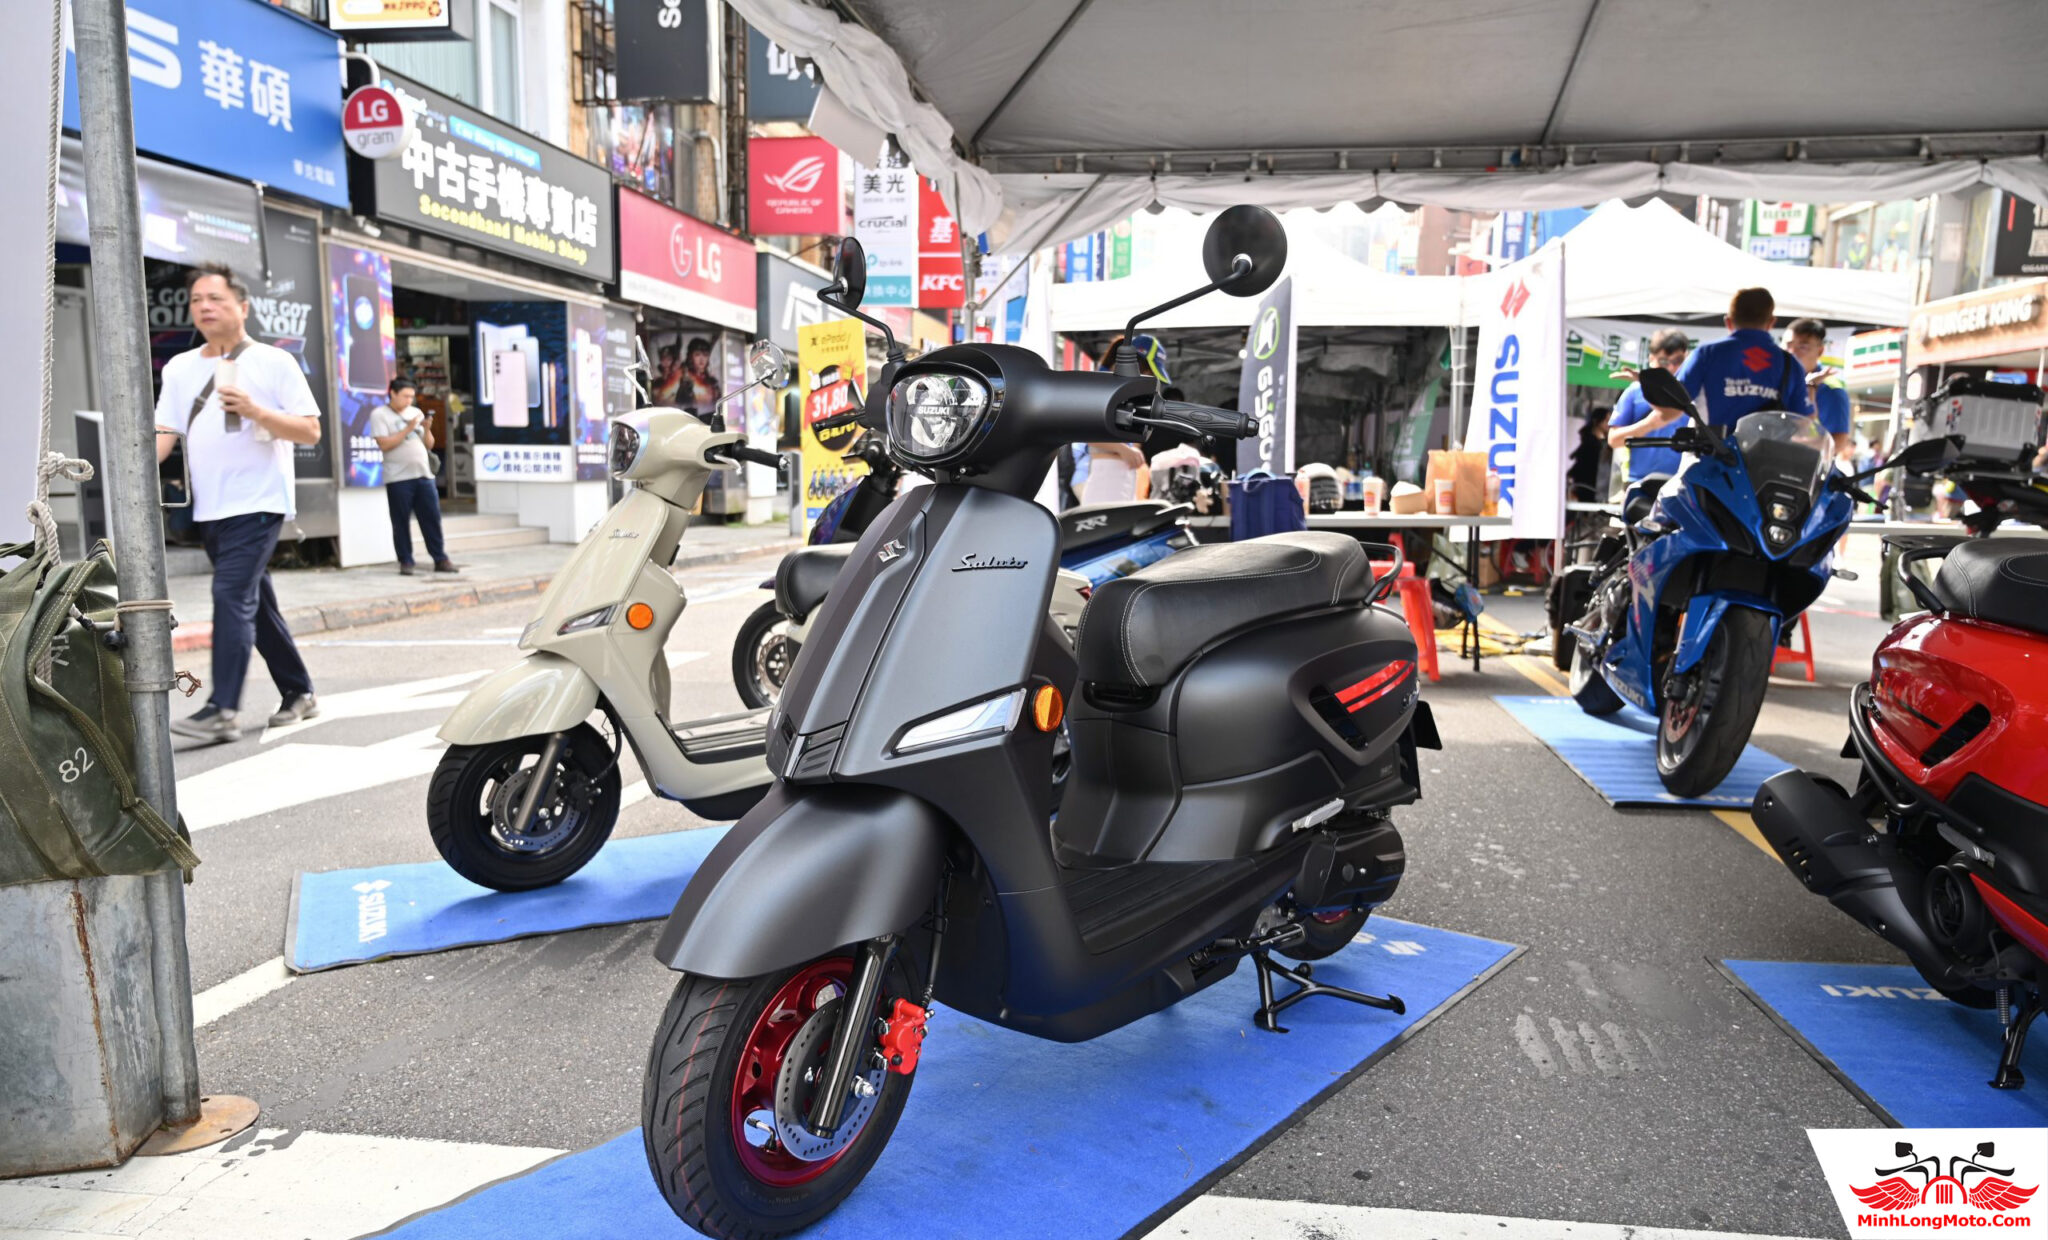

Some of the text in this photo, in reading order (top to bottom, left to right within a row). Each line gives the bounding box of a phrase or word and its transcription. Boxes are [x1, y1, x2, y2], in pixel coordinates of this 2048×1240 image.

[199, 40, 292, 131] 華碩
[357, 100, 389, 124] LG
[356, 130, 394, 147] gram
[863, 173, 906, 194] 美光
[858, 215, 908, 229] crucial
[696, 236, 723, 284] LG
[920, 274, 964, 291] KFC
[250, 296, 313, 320] WE GOT
[1928, 294, 2034, 338] BURGER KING
[256, 313, 307, 336] YOU
[917, 406, 950, 415] SUZUKI
[952, 553, 1028, 572] Saluto
[58, 746, 95, 784] 82
